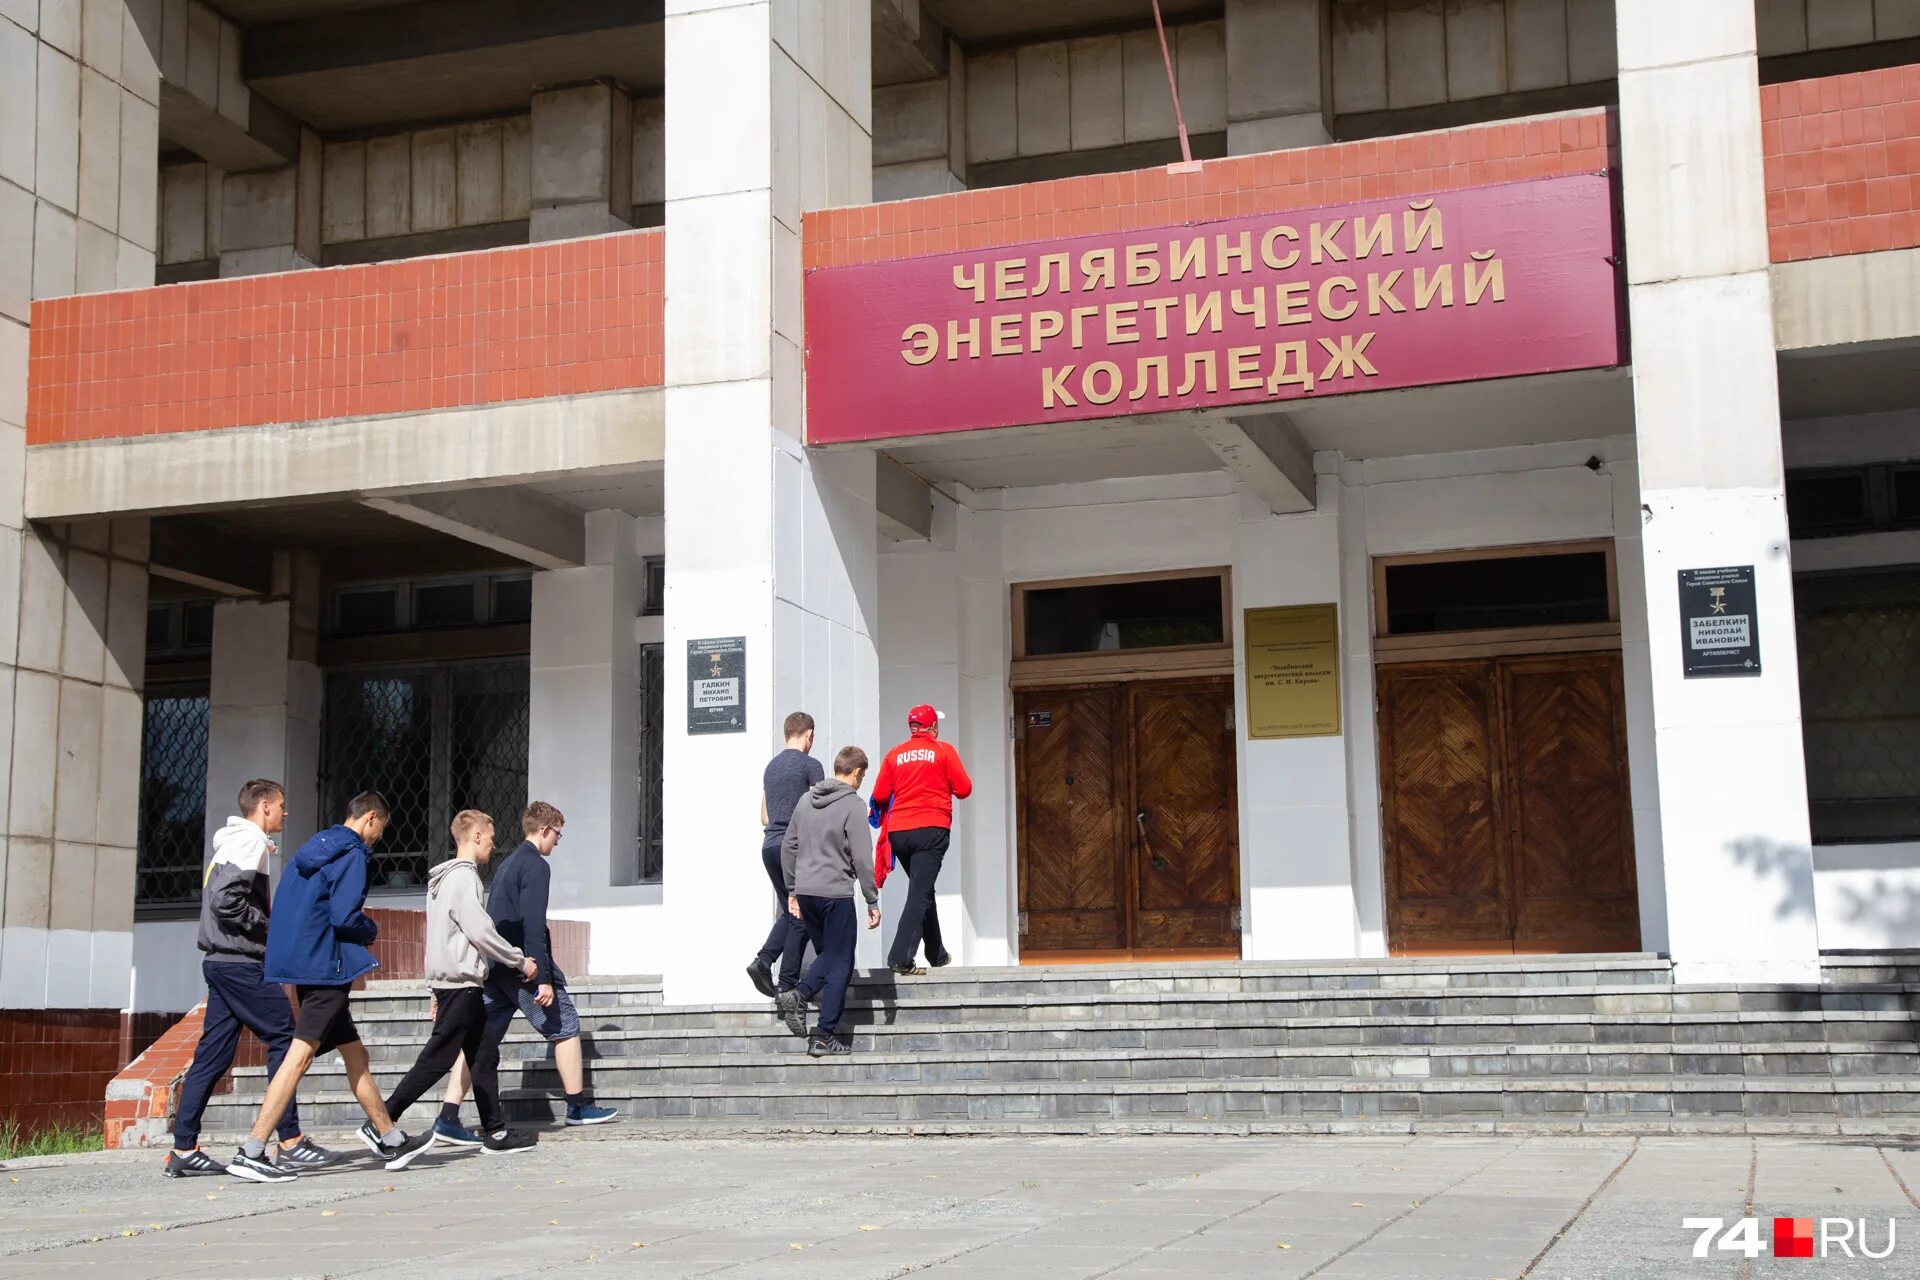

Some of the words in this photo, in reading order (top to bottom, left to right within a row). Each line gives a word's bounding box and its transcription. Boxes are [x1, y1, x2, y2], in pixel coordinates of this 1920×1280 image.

[953, 199, 1444, 303] ЧЕЛЯБИНСКИЙ
[900, 249, 1505, 365] ЭНЕРГЕТИЧЕСКИЙ
[1042, 332, 1379, 408] КОЛЛЕДЖ
[1692, 618, 1747, 628] ЗАБЕЛКИН
[1698, 627, 1742, 636] НИКОЛАЙ
[1695, 635, 1746, 645] ИВАНОВИЧ
[702, 681, 730, 689] ГАЛКИН
[702, 688, 730, 696] МИХАИЛ
[699, 695, 733, 703] ПЕТРОВИЧ
[896, 749, 935, 766] RUSSIA
